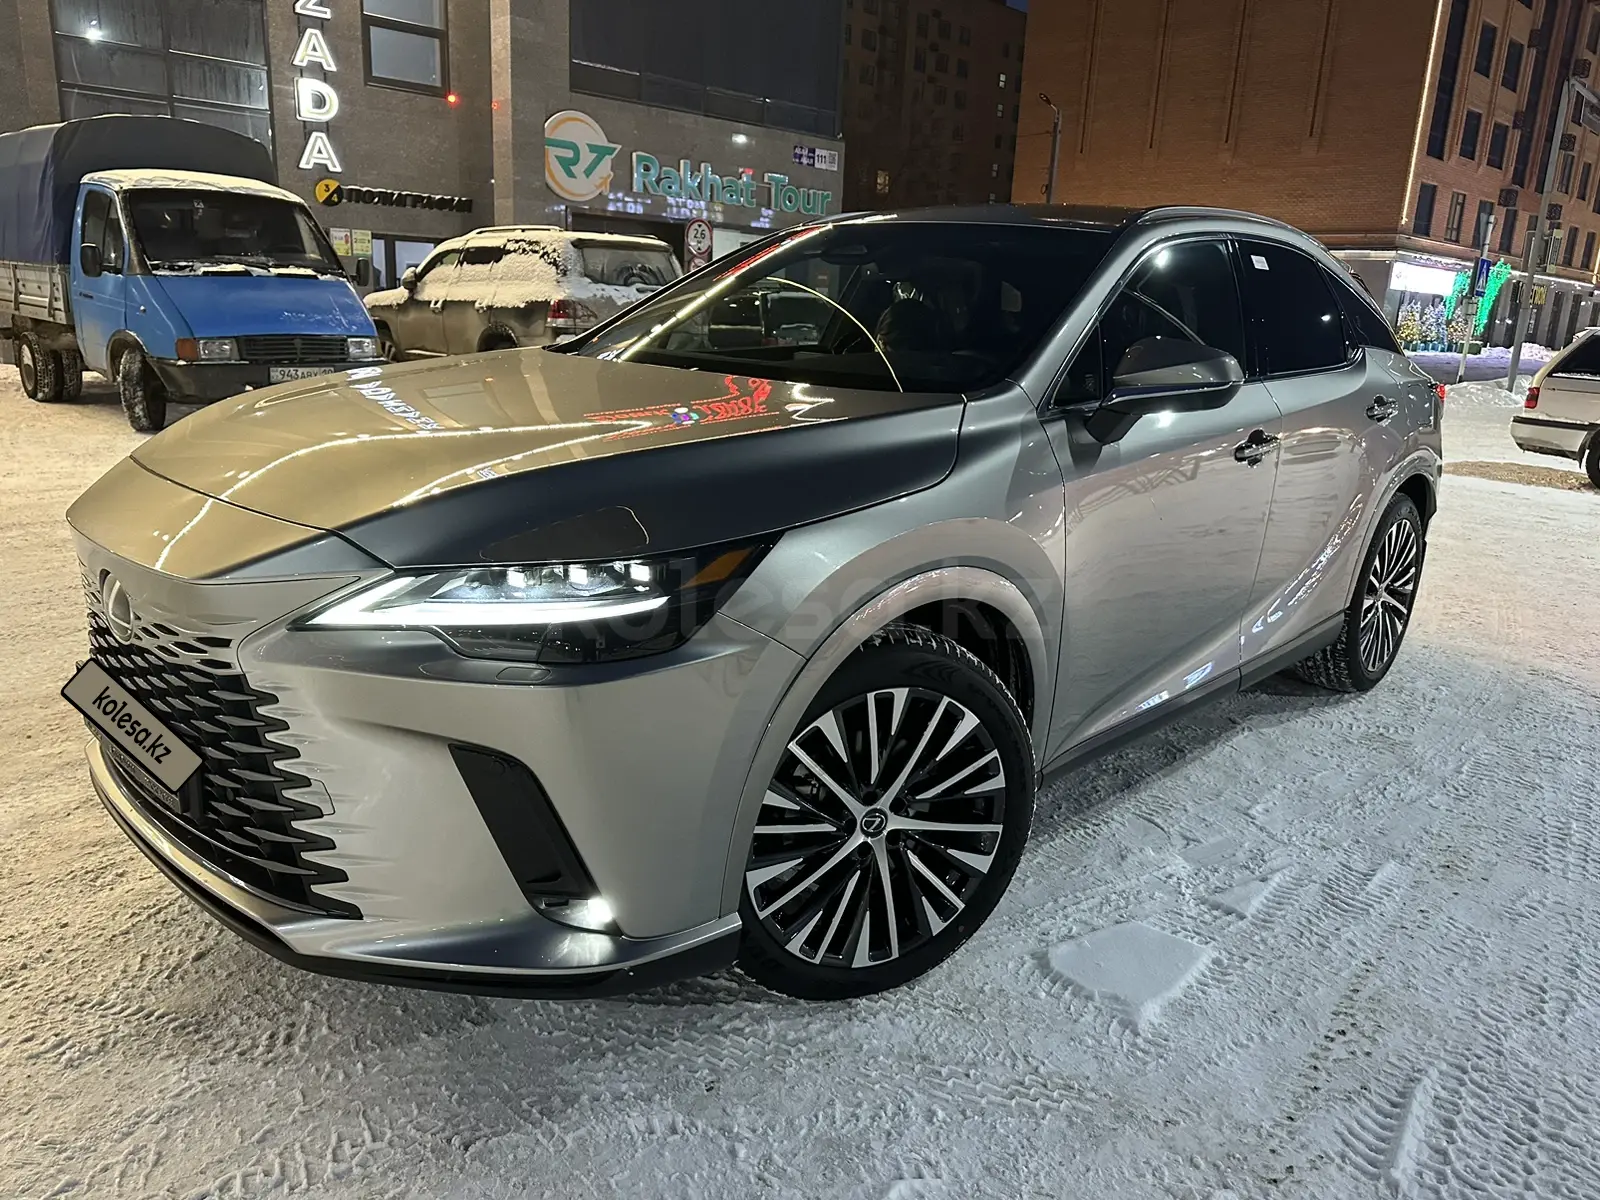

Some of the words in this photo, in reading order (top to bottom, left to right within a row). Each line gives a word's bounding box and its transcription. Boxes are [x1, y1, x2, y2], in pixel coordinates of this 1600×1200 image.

[816, 153, 827, 165] 111
[632, 150, 756, 208] Rakhat
[764, 172, 832, 216] Tour
